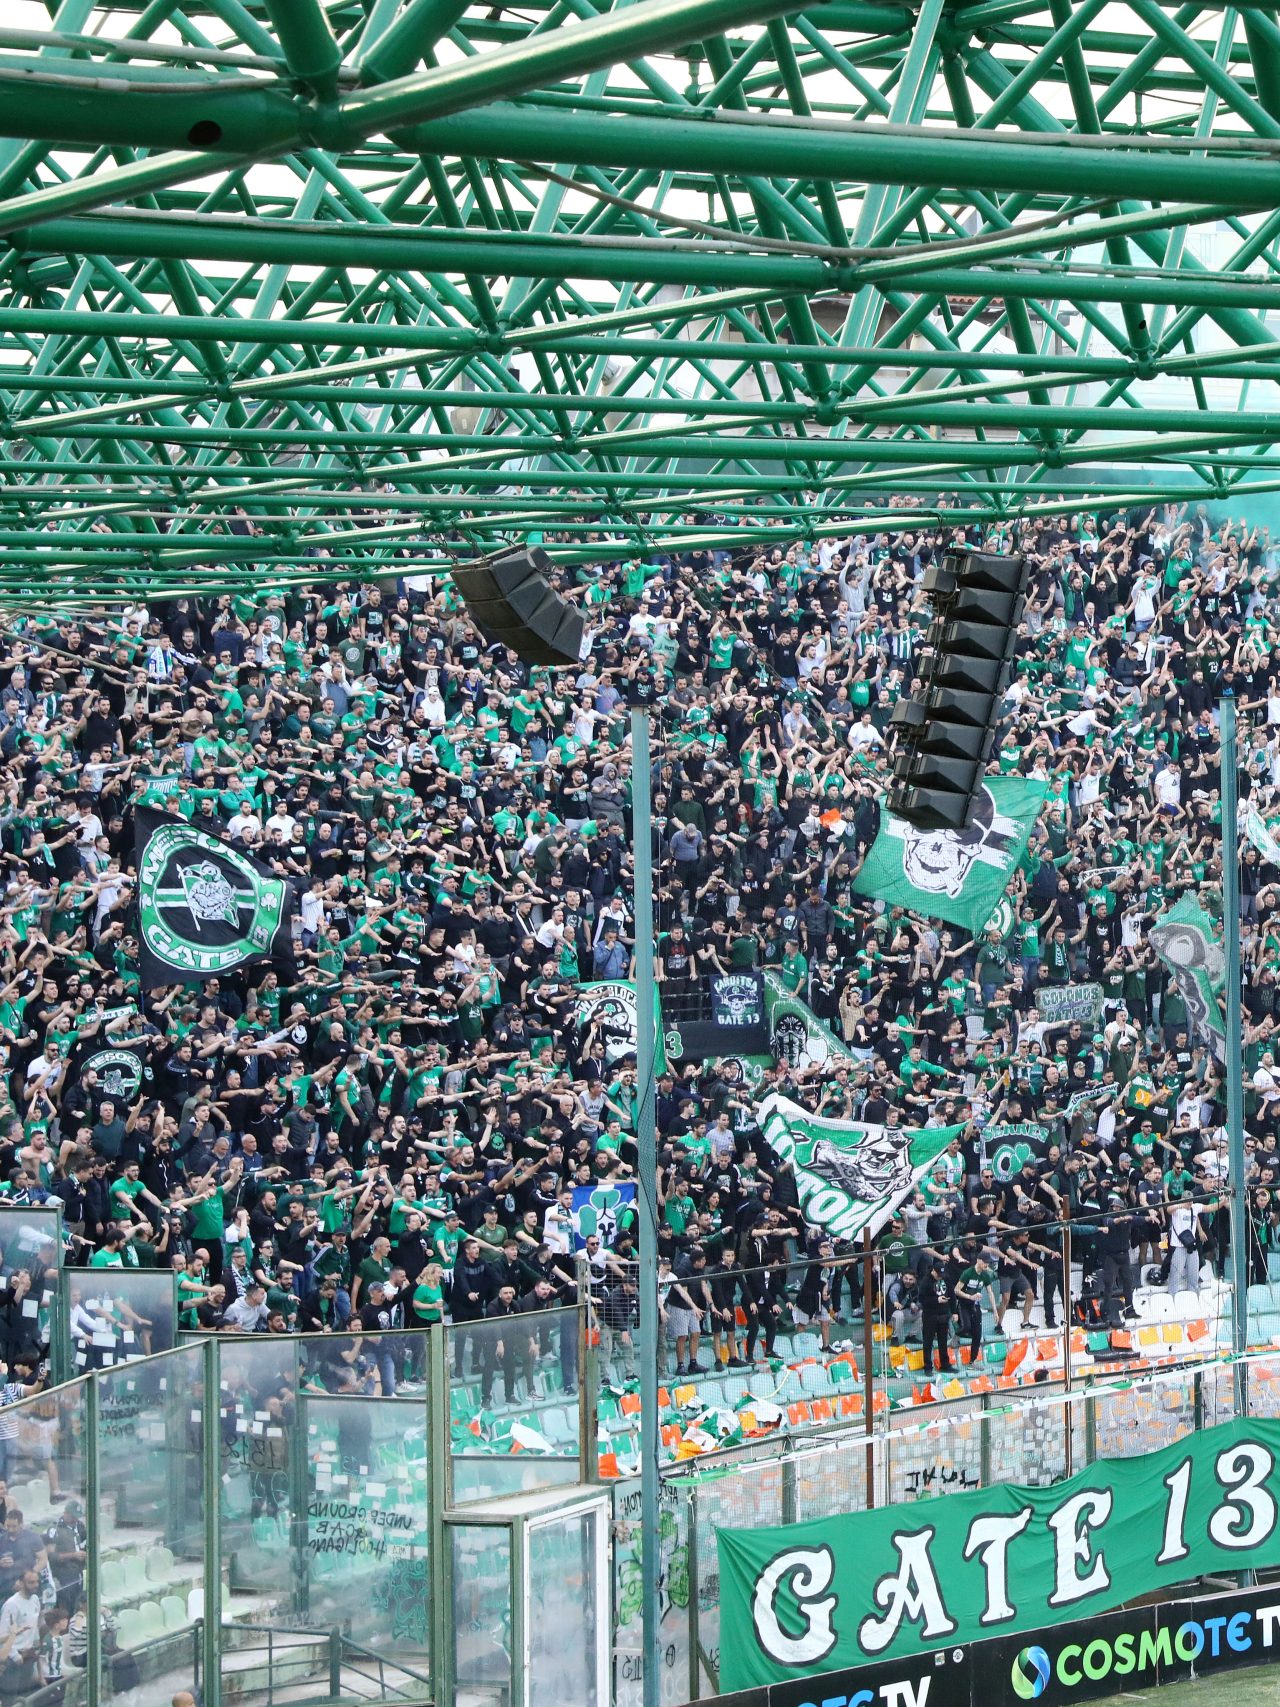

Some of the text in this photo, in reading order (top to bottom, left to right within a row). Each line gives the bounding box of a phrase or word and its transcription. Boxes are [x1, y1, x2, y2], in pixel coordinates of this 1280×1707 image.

[147, 924, 243, 968] GATE
[718, 1013, 760, 1025] GATE 13
[666, 1031, 684, 1059] 3
[752, 1439, 1277, 1668] GATE 13
[1055, 1611, 1252, 1683] COSMOTE
